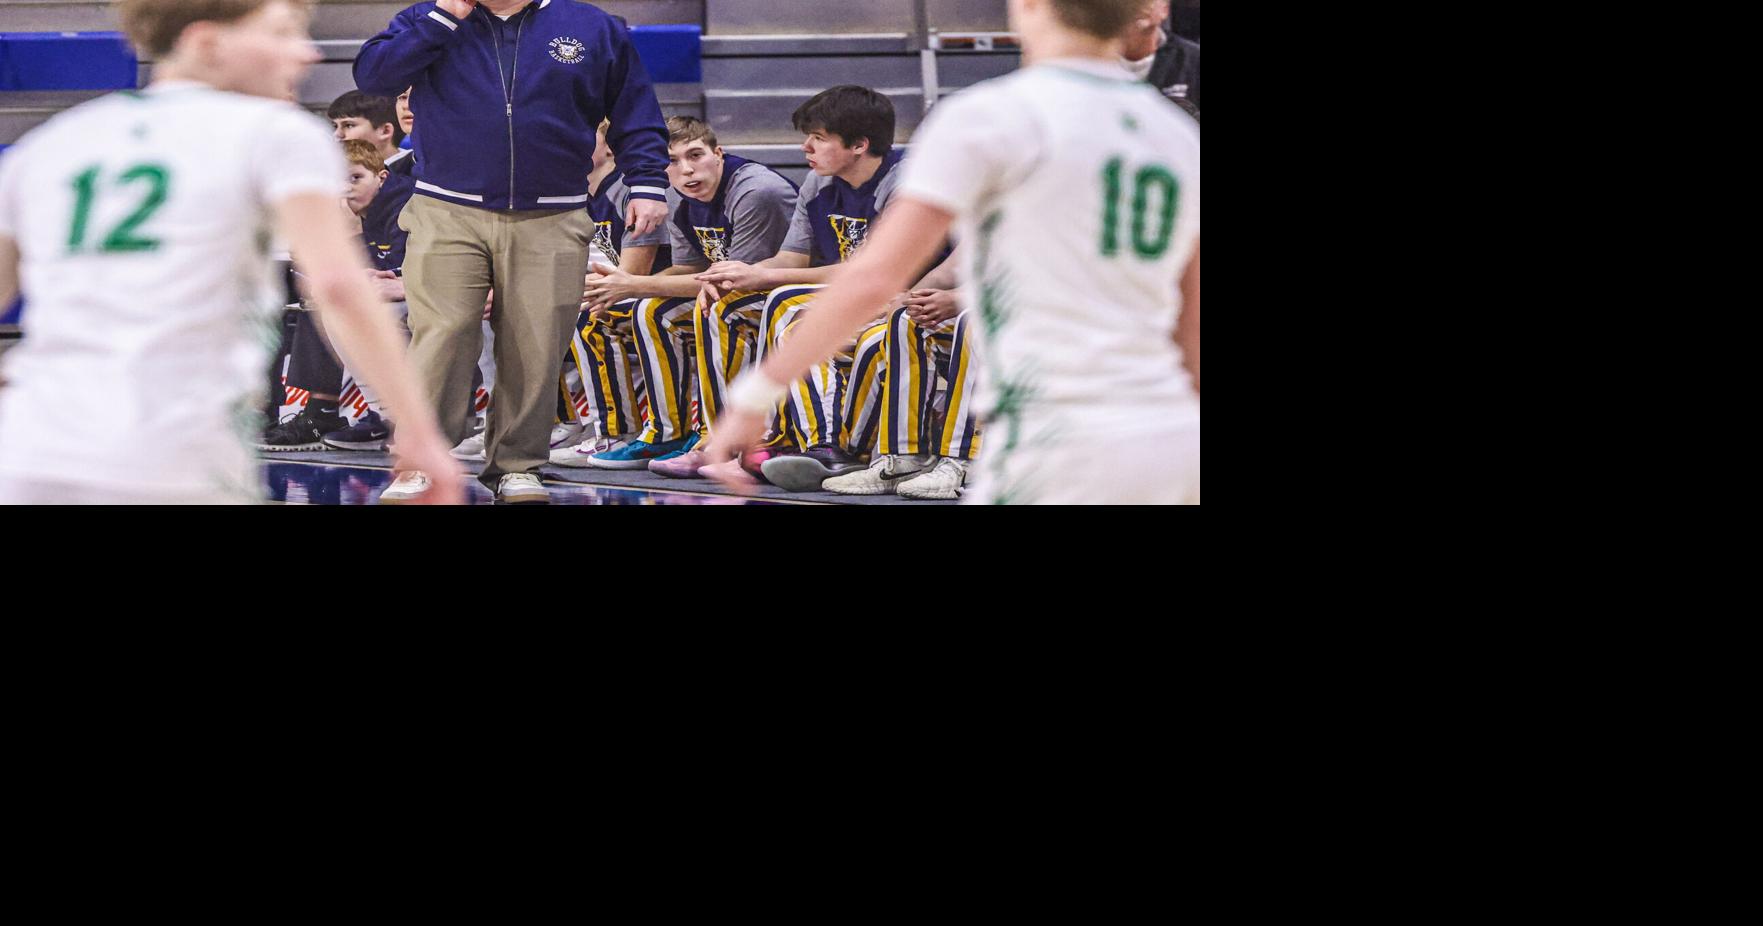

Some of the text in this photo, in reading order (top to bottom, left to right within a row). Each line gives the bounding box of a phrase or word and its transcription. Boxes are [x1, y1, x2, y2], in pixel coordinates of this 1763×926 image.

[549, 37, 585, 51] BULLDOG
[549, 50, 584, 64] BASKETBALL
[68, 164, 168, 253] 12
[1101, 155, 1179, 260] 10
